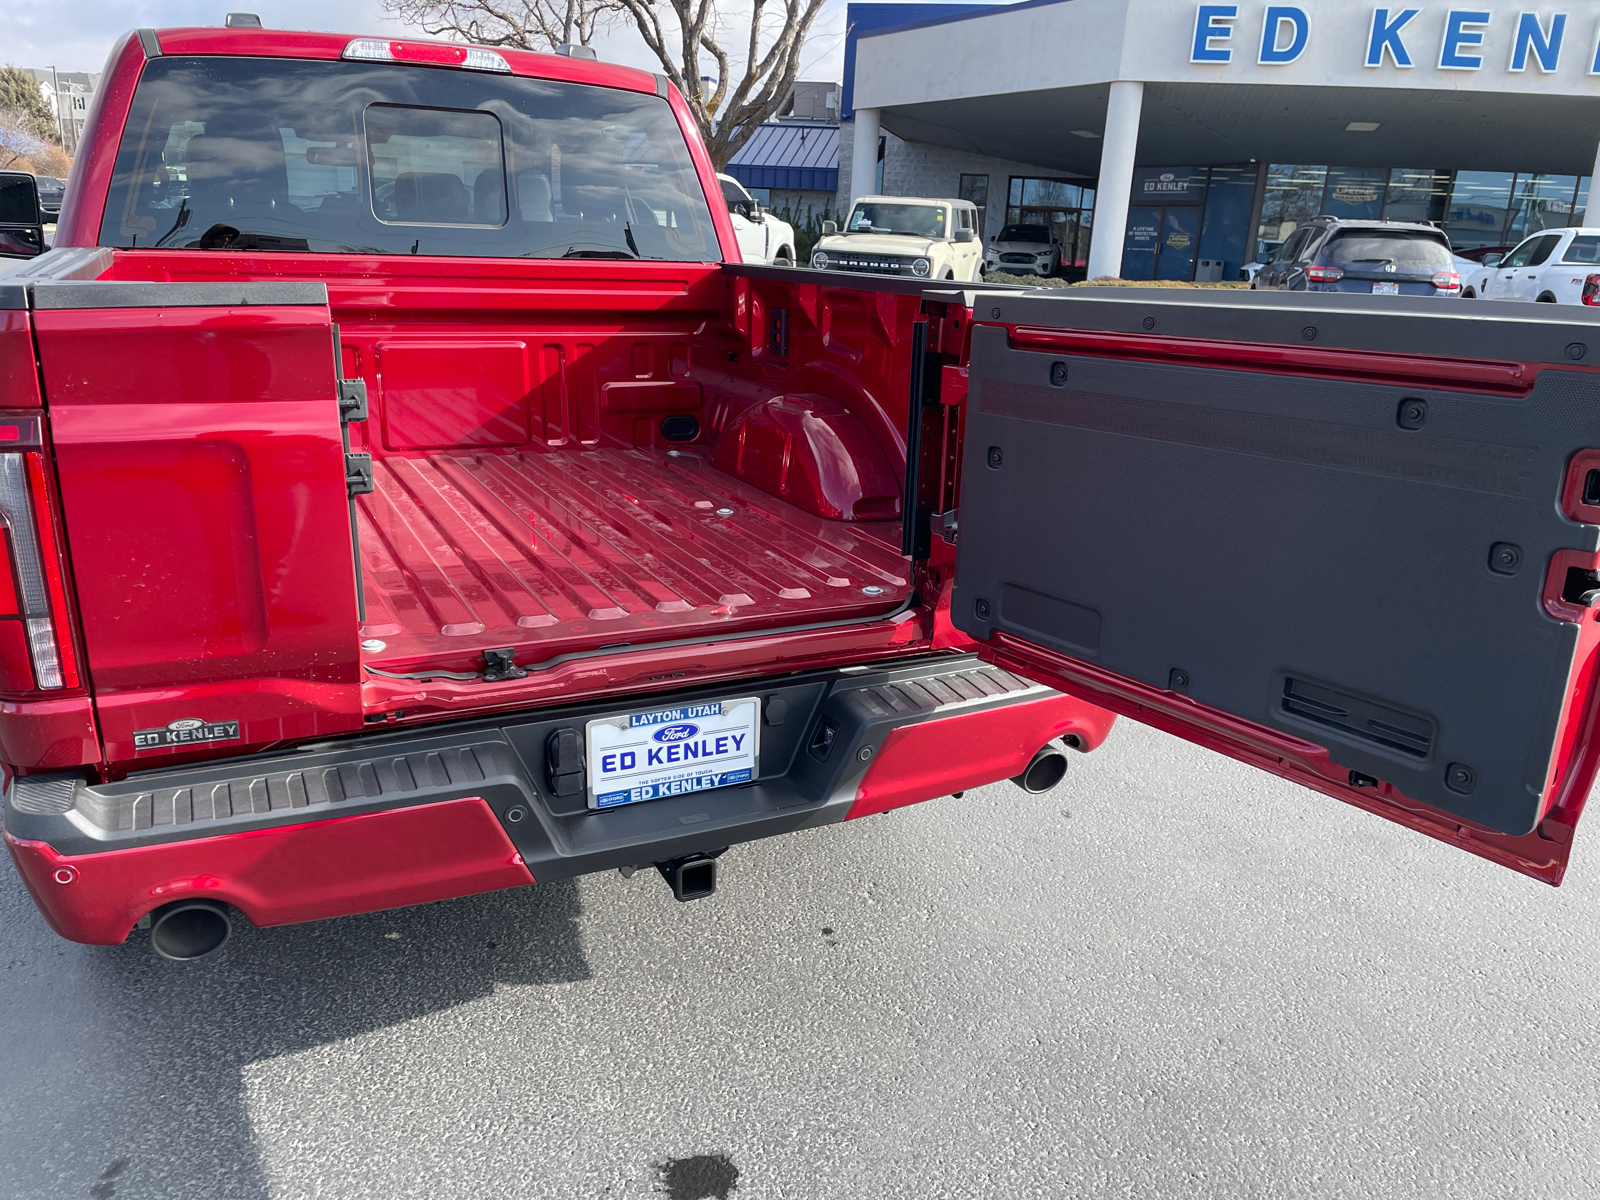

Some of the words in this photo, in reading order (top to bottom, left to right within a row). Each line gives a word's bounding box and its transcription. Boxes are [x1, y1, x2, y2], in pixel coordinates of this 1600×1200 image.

[1190, 4, 1311, 65] ED
[1144, 182, 1155, 190] ED
[1156, 182, 1188, 190] KENLEY
[632, 710, 684, 727] LAYTON,
[688, 704, 720, 718] UTAH
[134, 733, 159, 746] ED
[166, 724, 236, 742] KENLEY
[662, 727, 690, 741] Ford
[602, 752, 636, 772] ED
[648, 733, 746, 766] KENLEY
[630, 786, 653, 802] ED
[658, 774, 722, 796] KENLEY
